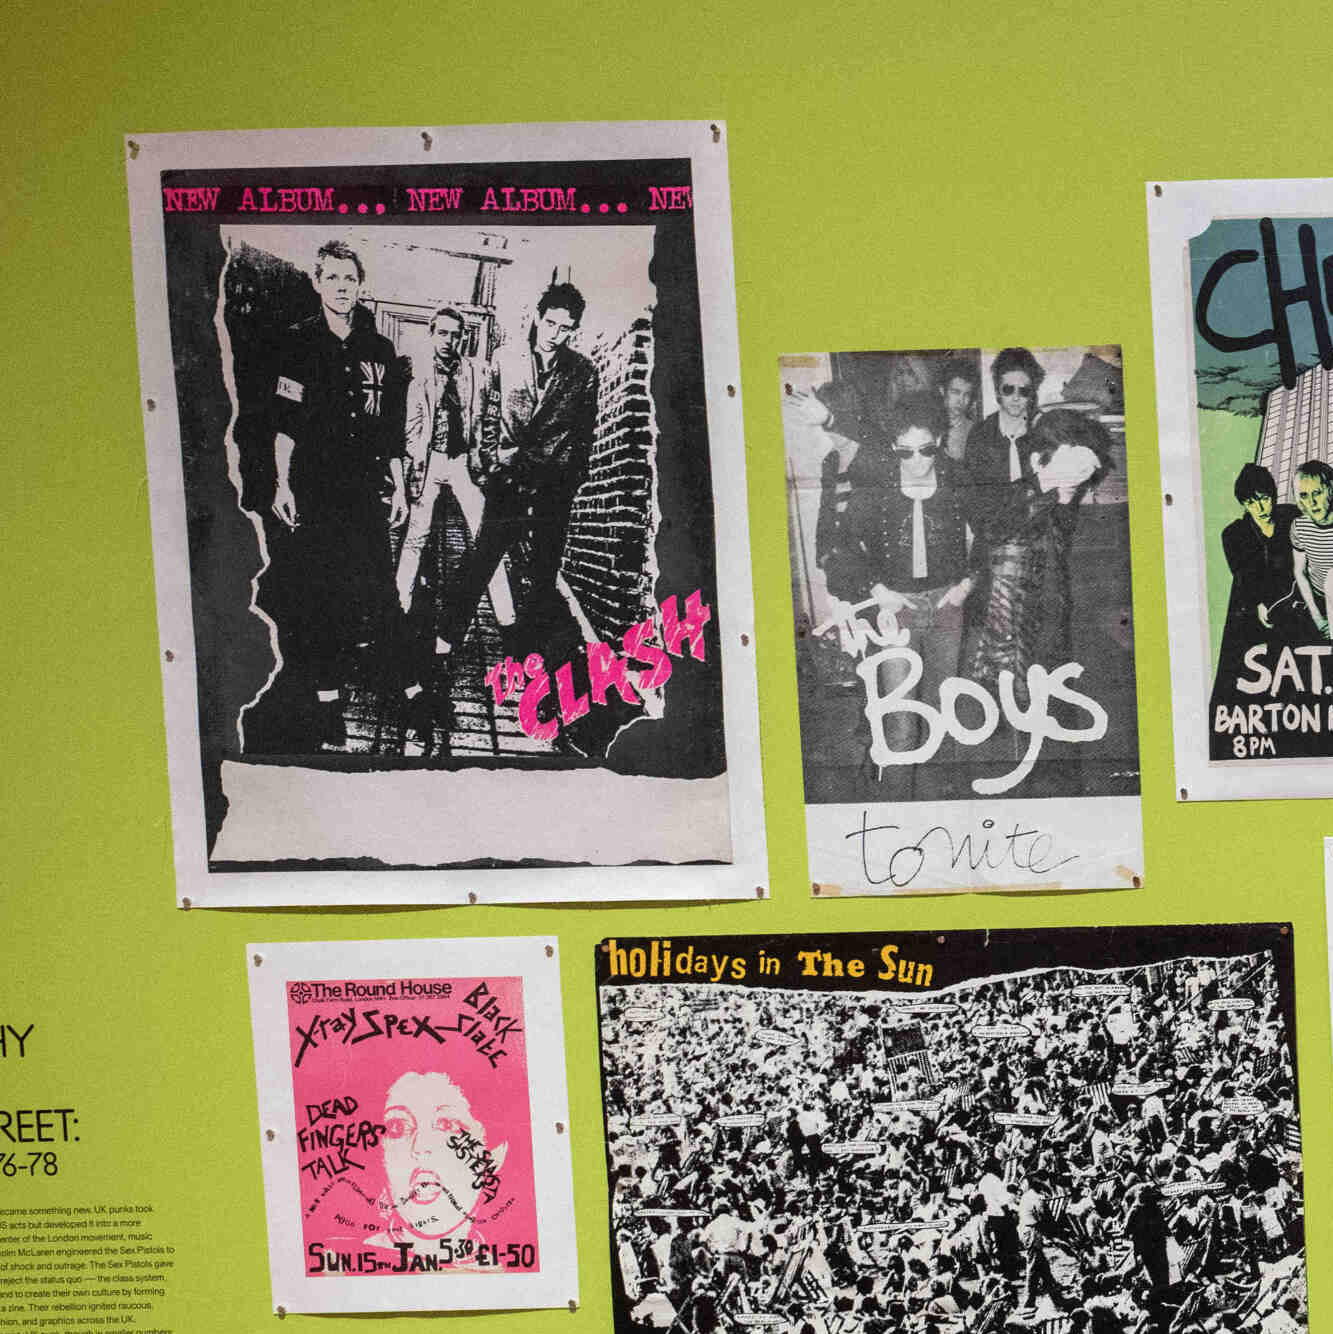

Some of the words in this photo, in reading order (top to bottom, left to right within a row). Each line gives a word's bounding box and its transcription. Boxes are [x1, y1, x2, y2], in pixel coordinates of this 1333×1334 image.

[164, 187, 220, 213] NEW
[407, 188, 463, 211] NEW
[518, 588, 711, 741] CLASH
[1236, 643, 1333, 696] SAT.
[1214, 702, 1321, 733] BARTON
[1232, 736, 1277, 758] 8PM
[759, 950, 781, 976] in
[798, 949, 866, 977] The
[878, 944, 934, 987] Sun
[312, 983, 342, 997] The
[345, 982, 396, 997] Round
[400, 981, 452, 995] House
[306, 1096, 358, 1126] DEAD
[297, 1121, 386, 1152] FINGERS
[301, 1150, 365, 1180] TALK
